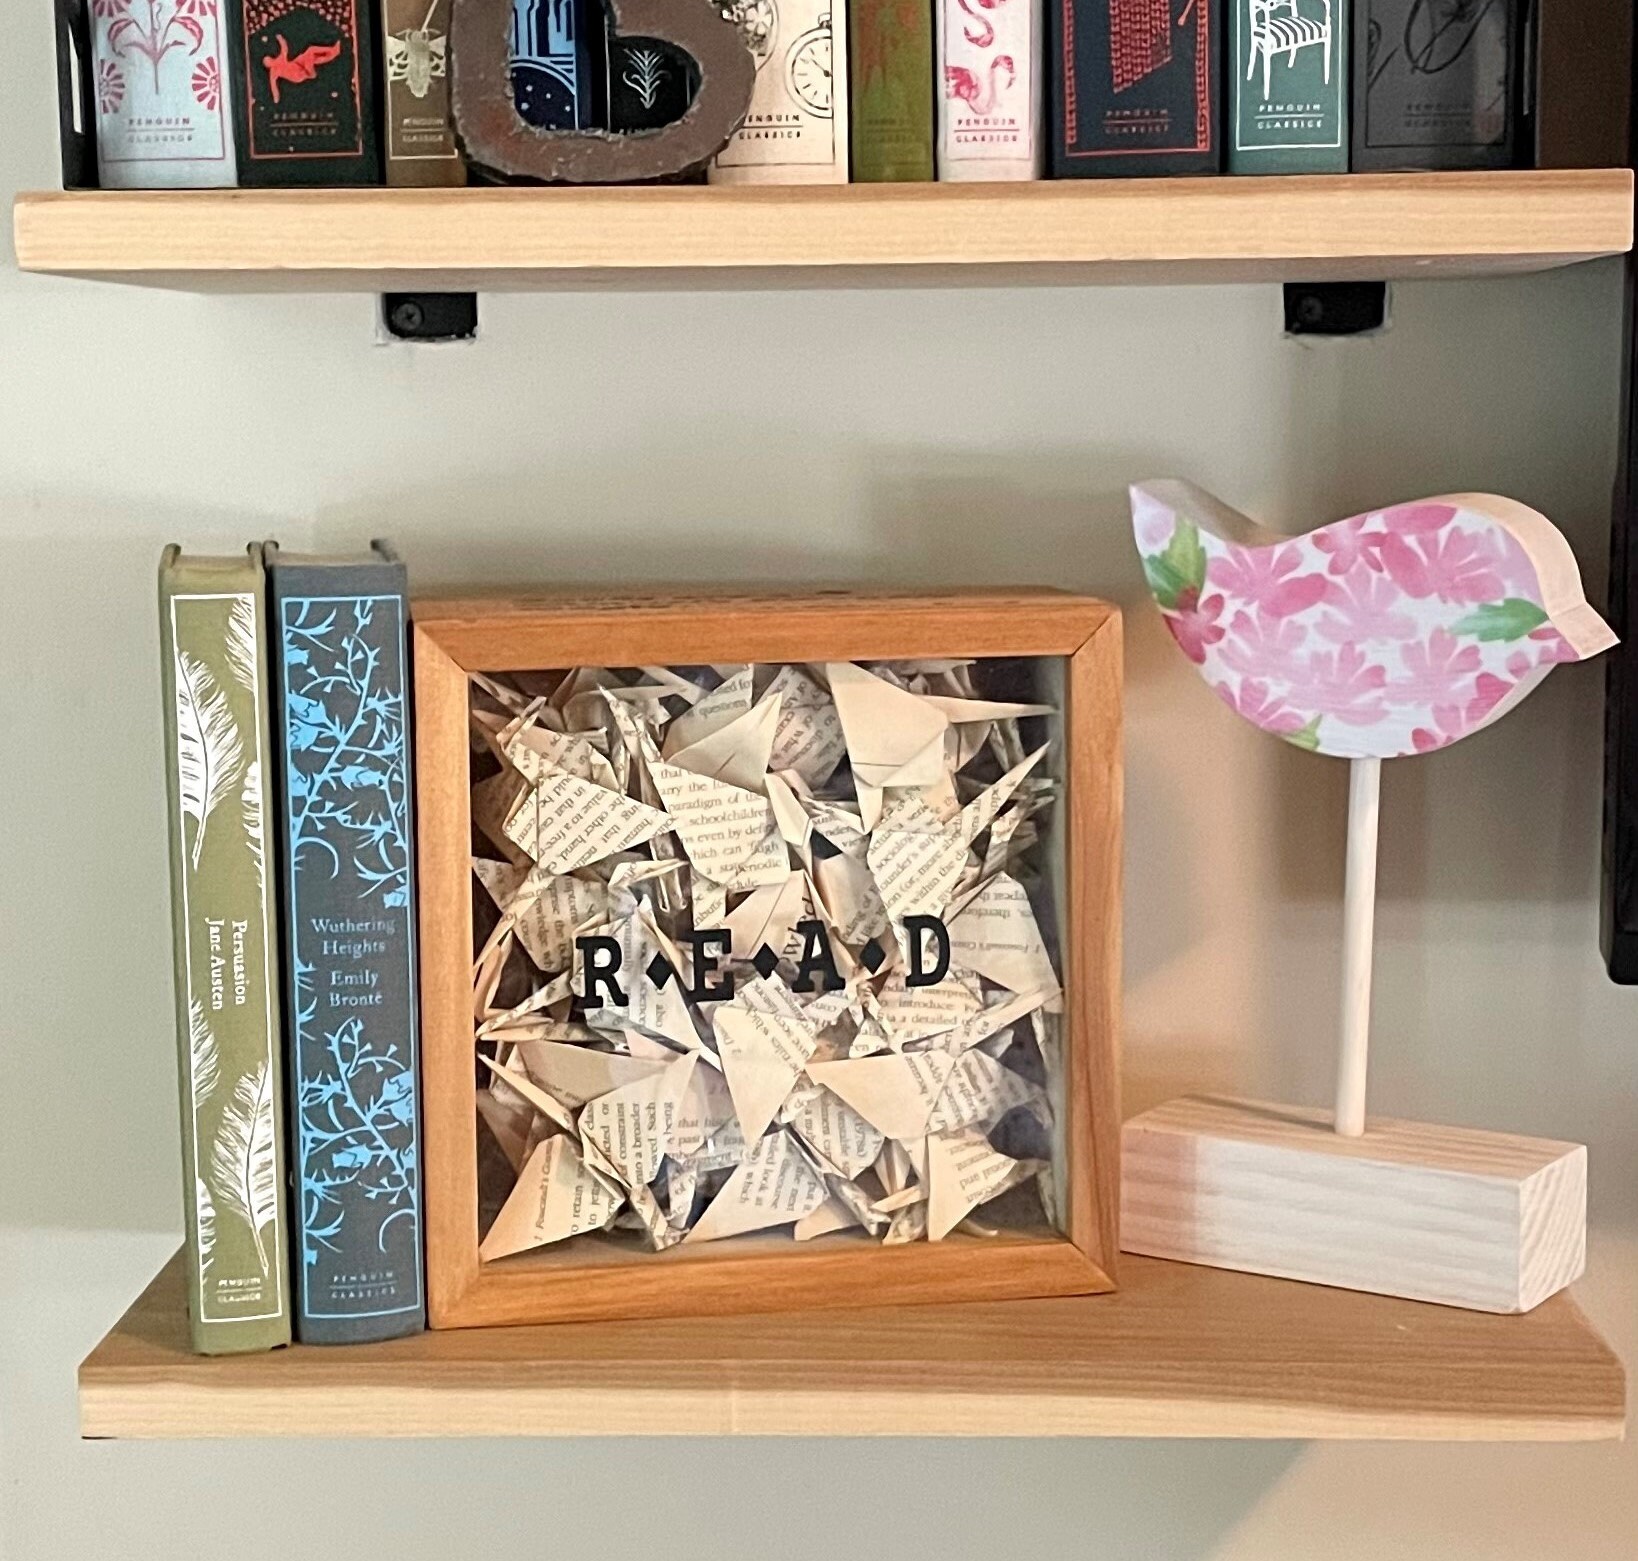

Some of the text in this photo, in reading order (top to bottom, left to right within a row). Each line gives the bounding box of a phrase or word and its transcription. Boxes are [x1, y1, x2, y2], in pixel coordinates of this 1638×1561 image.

[1258, 103, 1321, 112] PENGUIN
[748, 114, 800, 123] ENGUIN
[956, 118, 1017, 126] PENGUIN
[1257, 119, 1324, 130] CLASSICS
[553, 796, 575, 818] that
[580, 787, 609, 816] value
[668, 797, 722, 813] paradigm
[570, 811, 584, 827] to
[582, 809, 610, 838] other
[697, 831, 725, 842] even
[728, 828, 743, 838] by
[310, 917, 396, 935] Wuthering
[322, 939, 386, 959] Heights
[204, 917, 226, 1010] Jane Austen
[231, 919, 250, 1005] Persuasion
[330, 969, 379, 988] Emily
[601, 1102, 608, 1115] or
[645, 1101, 656, 1131] Such
[617, 1102, 626, 1159] constraint
[631, 1102, 641, 1148] broader
[634, 1161, 643, 1184] into
[758, 1168, 773, 1193] look
[571, 1184, 583, 1217] retain
[587, 1213, 597, 1225] to
[333, 1271, 394, 1283] PENGUIN
[331, 1286, 396, 1300] CLASSICS
